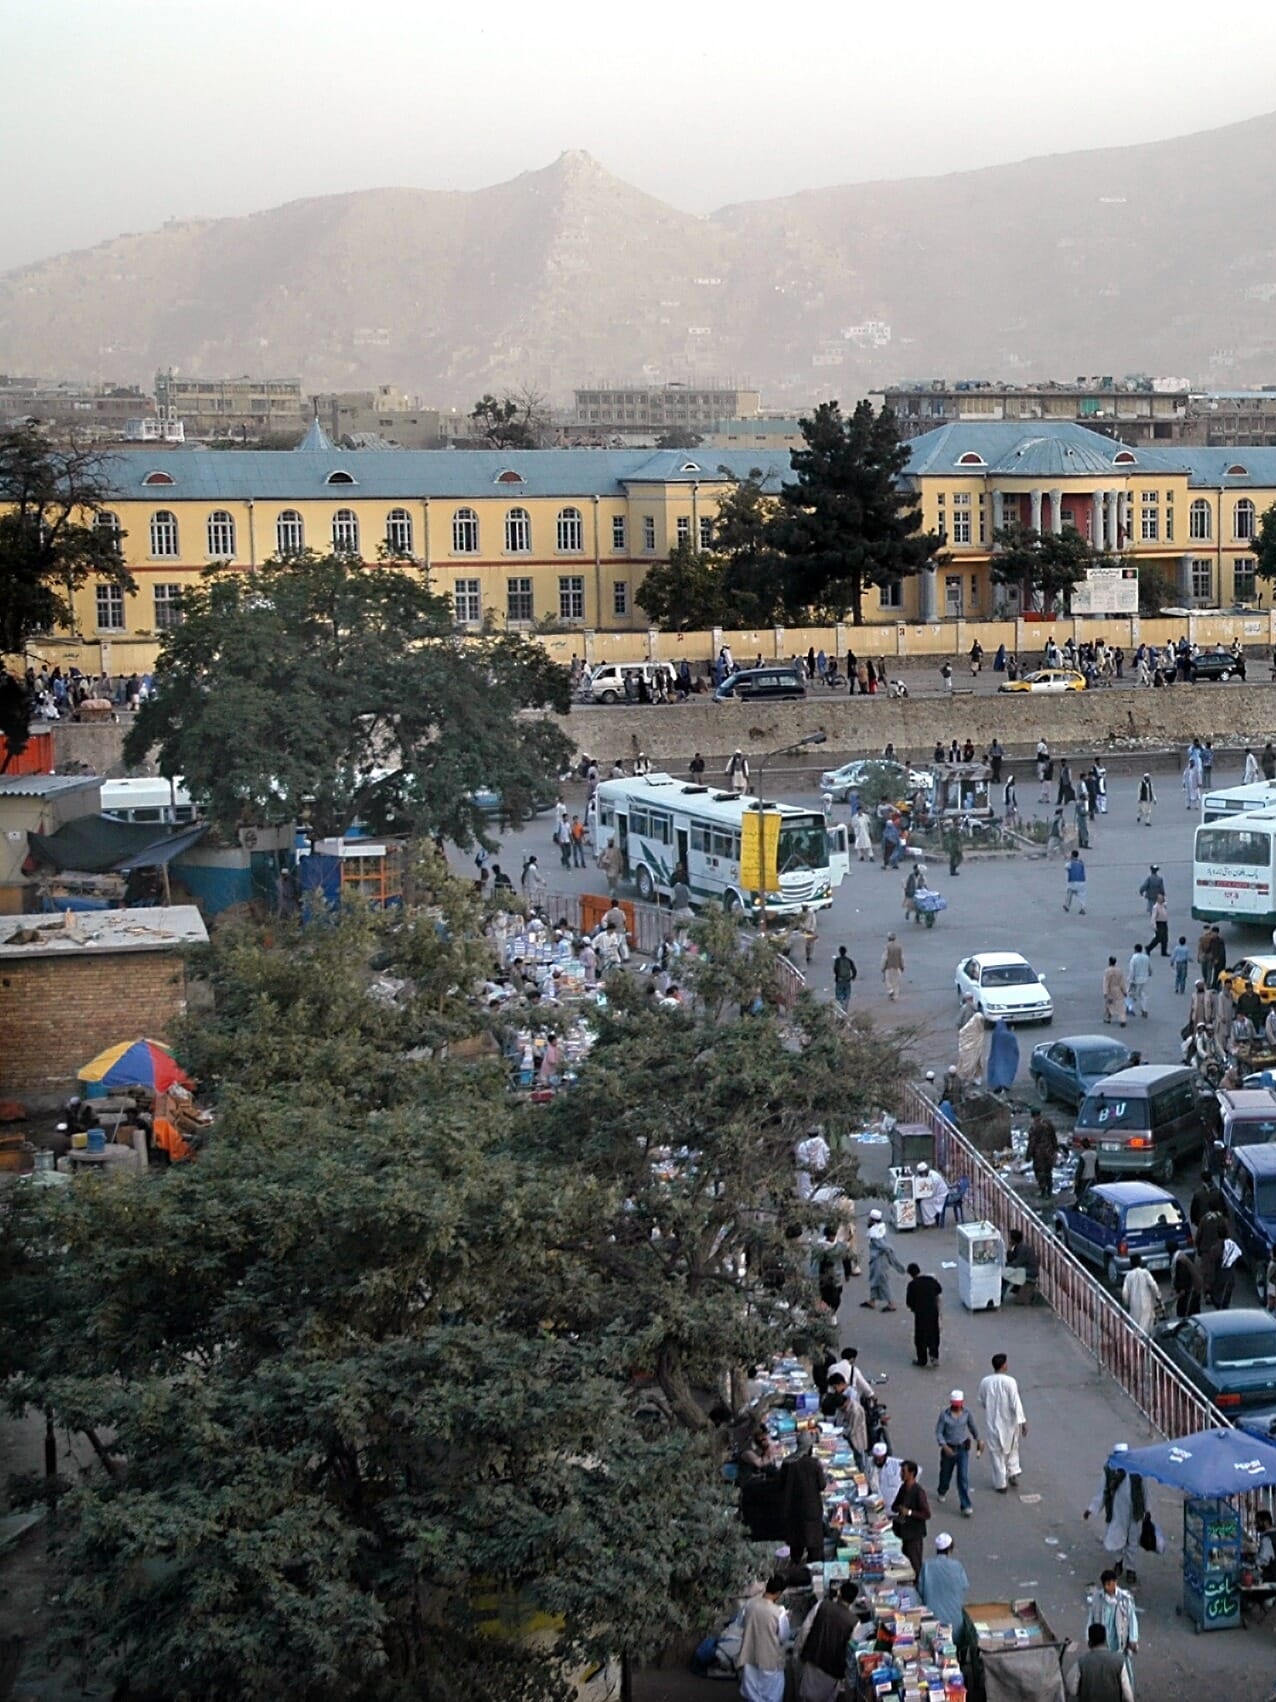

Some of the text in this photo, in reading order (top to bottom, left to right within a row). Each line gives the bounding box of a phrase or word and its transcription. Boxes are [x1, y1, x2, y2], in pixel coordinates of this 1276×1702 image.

[1233, 1459, 1262, 1470] PEPSI
[1204, 1576, 1236, 1597] ساعت
[1208, 1597, 1236, 1617] سازی
